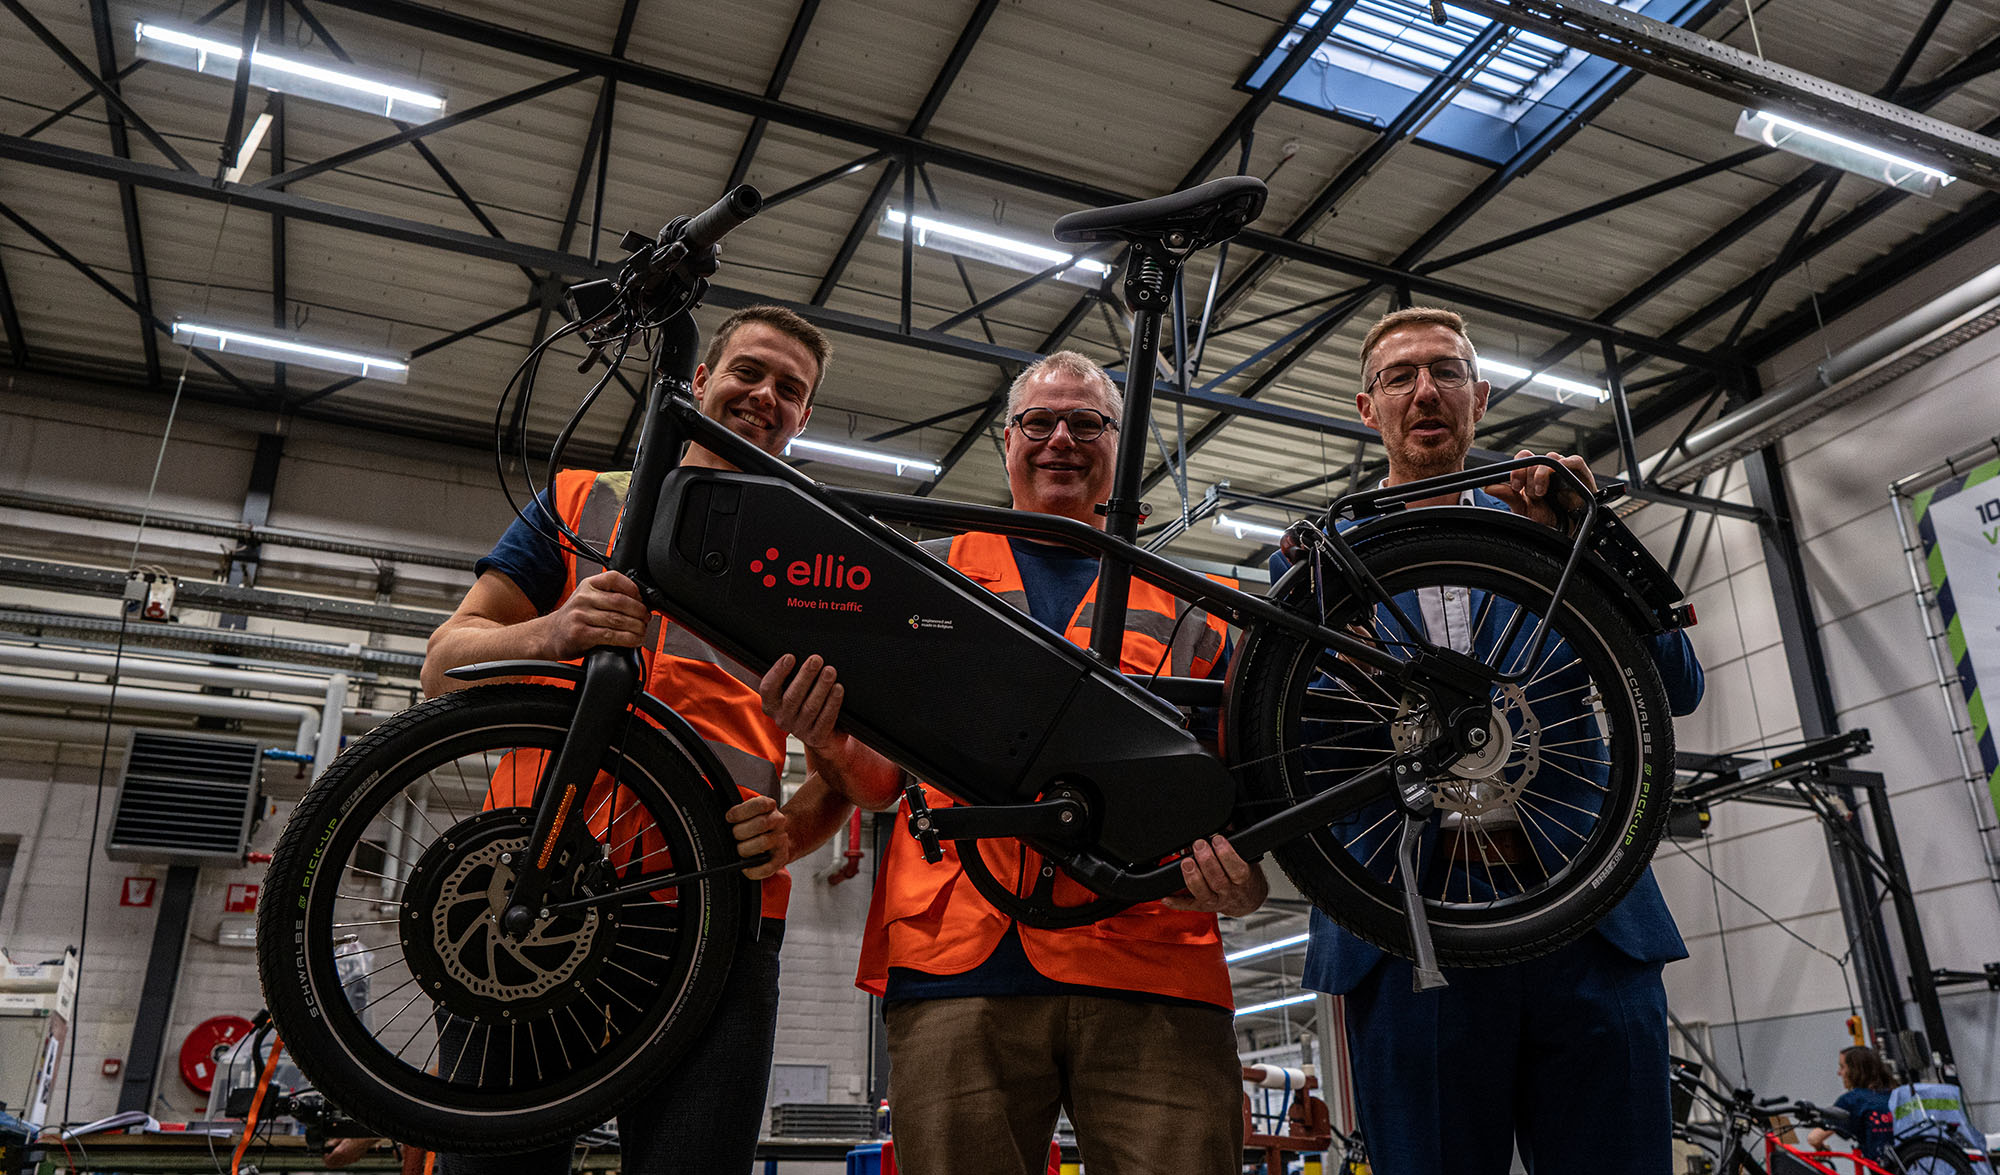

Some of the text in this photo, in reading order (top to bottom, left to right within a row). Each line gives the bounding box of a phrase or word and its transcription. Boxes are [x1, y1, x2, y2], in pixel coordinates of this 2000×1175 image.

[786, 553, 871, 591] ellio
[787, 597, 863, 613] Move in traffic
[1624, 667, 1653, 754] SCHWALBE
[1625, 782, 1650, 846] PICK-UP
[302, 818, 337, 888] PICK-UP
[295, 919, 320, 1018] SCHWALBE
